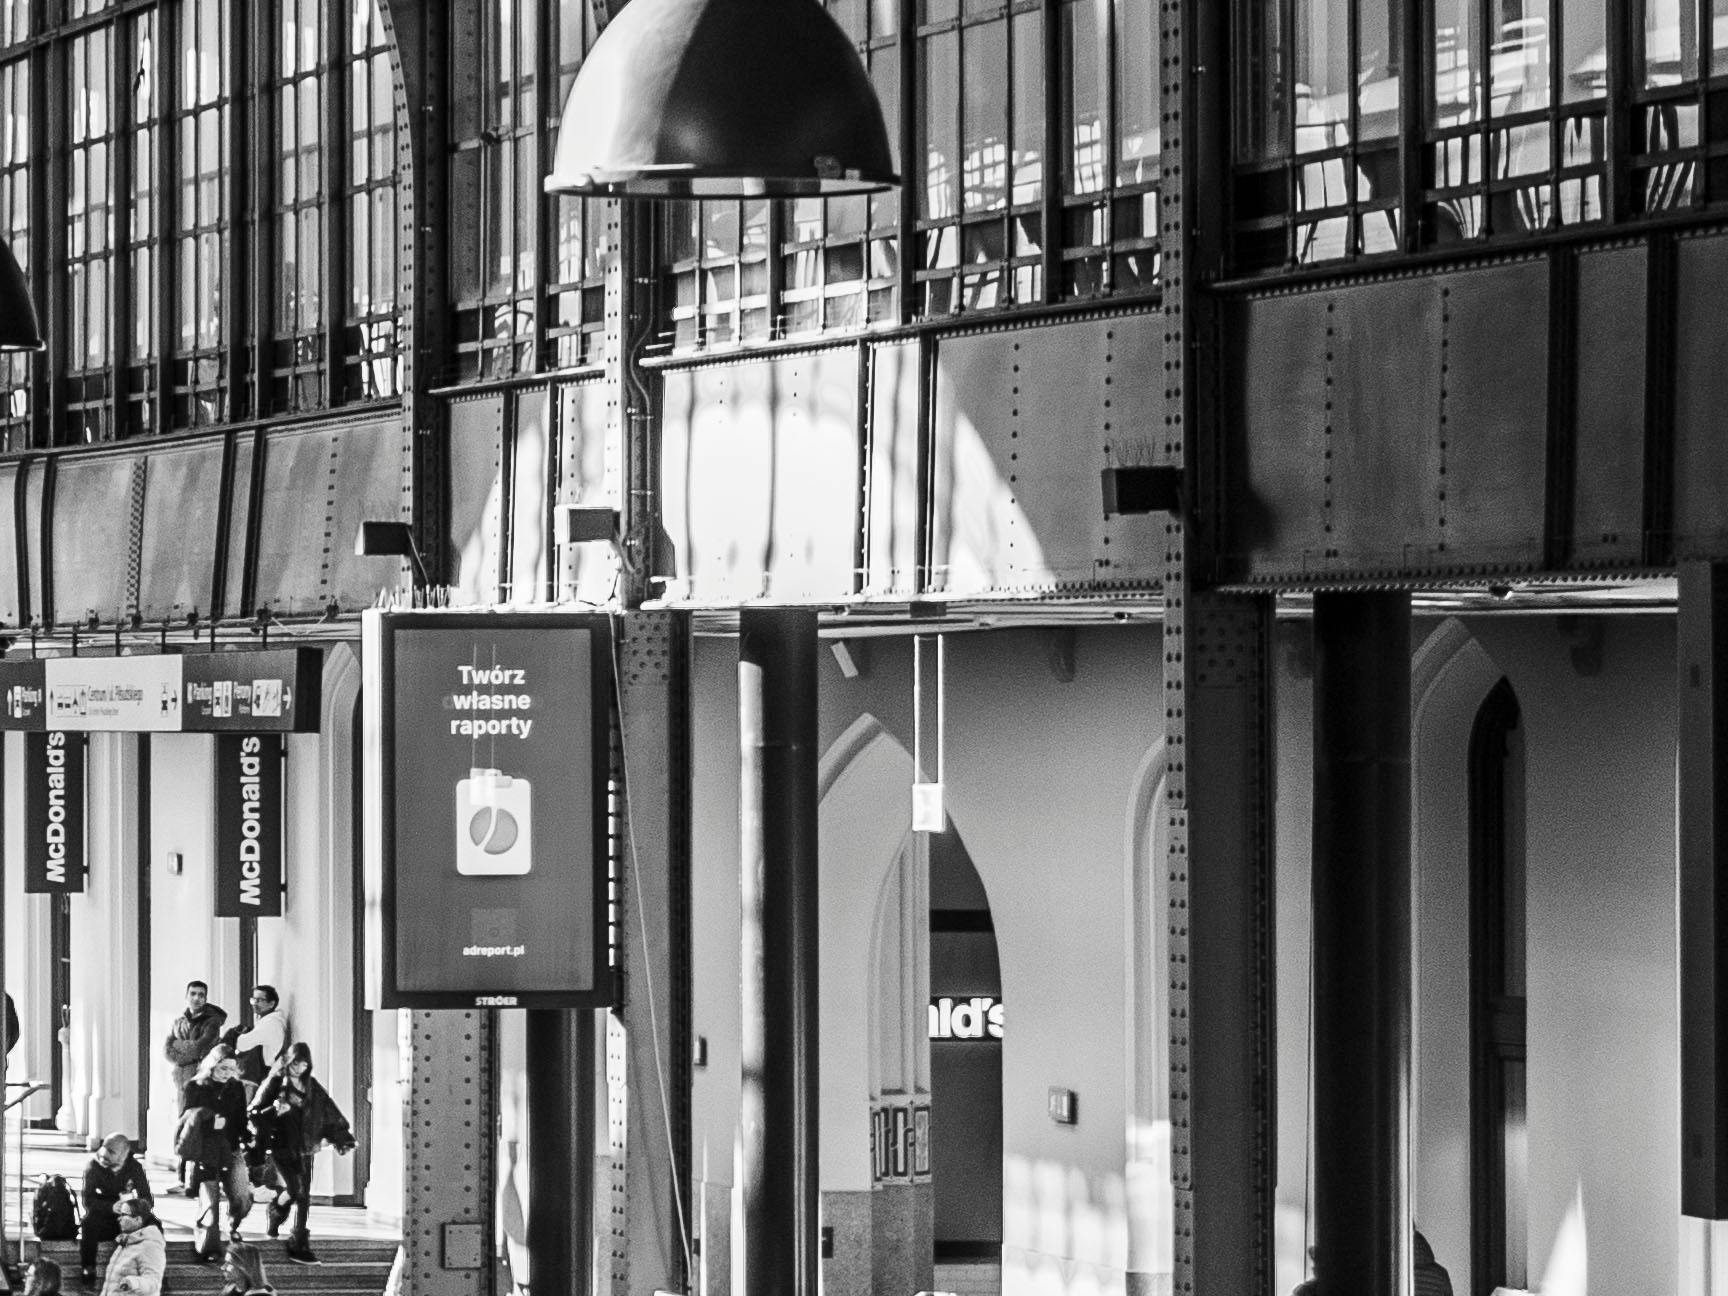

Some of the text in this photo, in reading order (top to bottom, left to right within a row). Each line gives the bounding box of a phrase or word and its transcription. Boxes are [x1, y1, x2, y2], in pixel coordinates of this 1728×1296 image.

[456, 664, 526, 685] Twórz
[452, 690, 532, 710] własne
[450, 716, 533, 740] raporty
[46, 731, 66, 884] McDonald's
[239, 736, 261, 905] McDonald's
[462, 944, 525, 958] adreport.pl
[475, 994, 518, 1006] STRÖER
